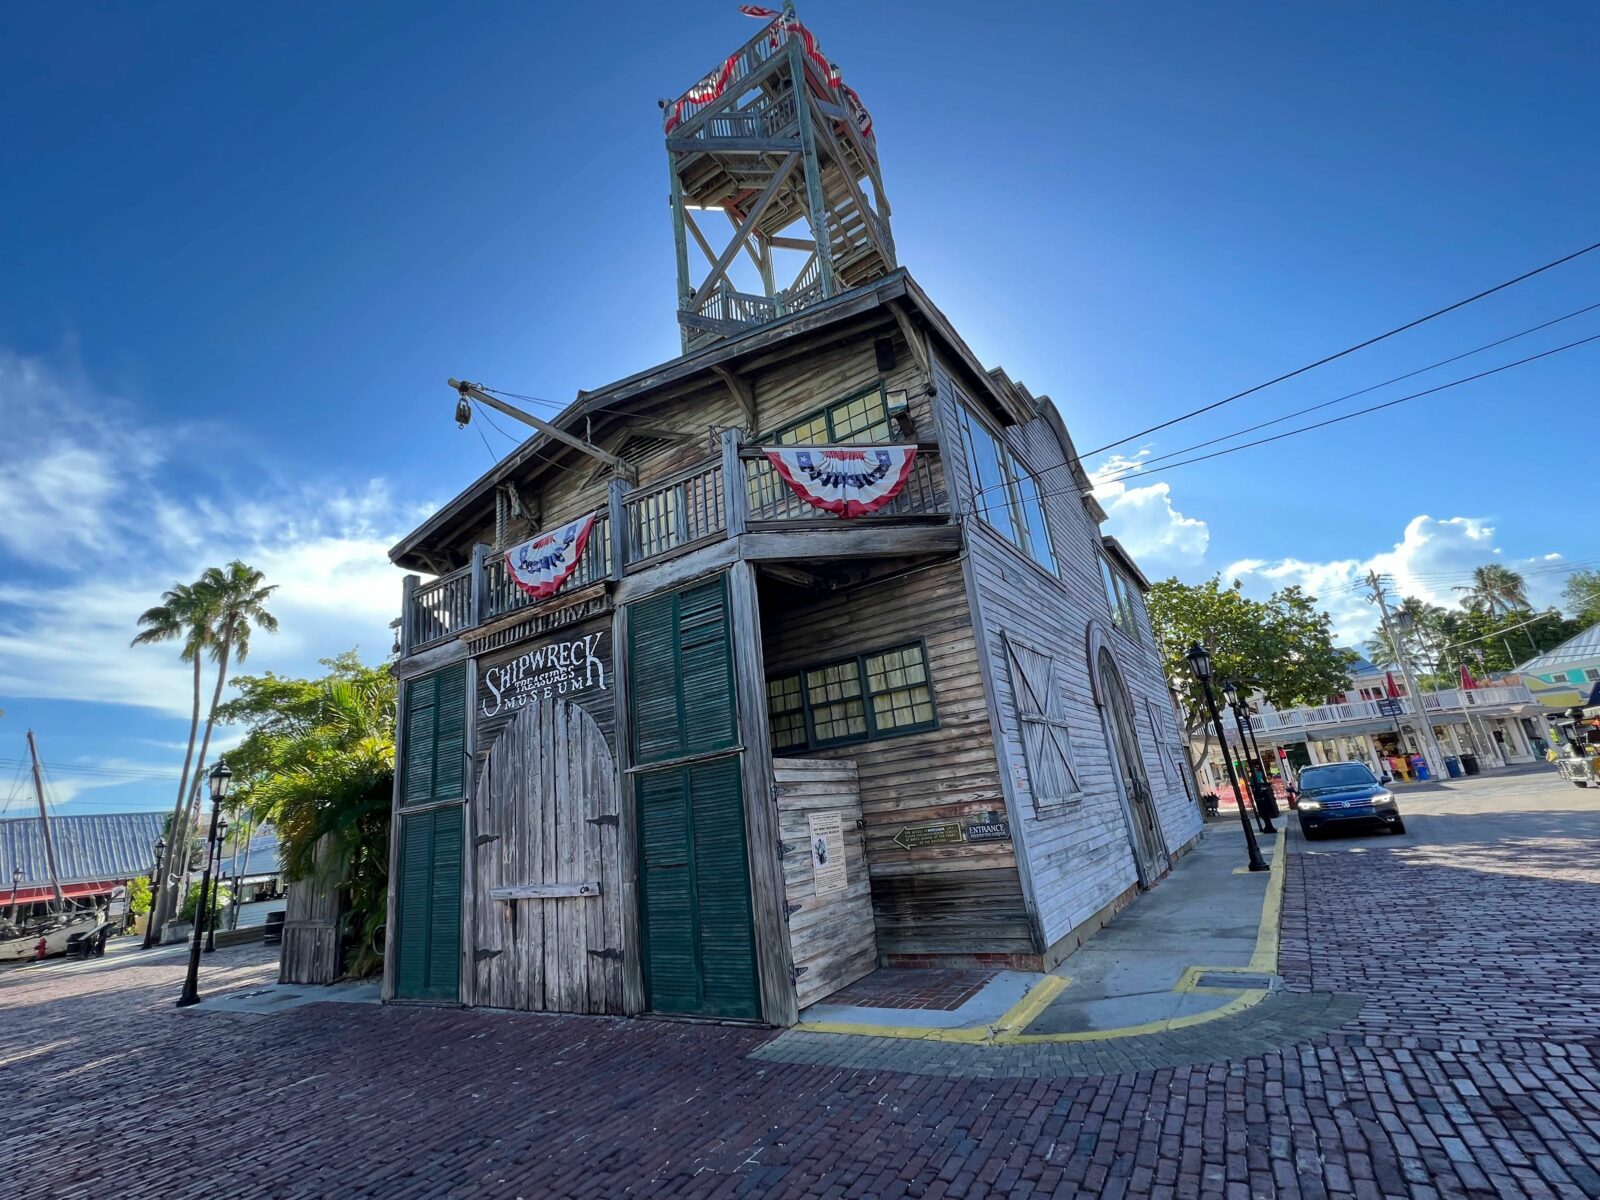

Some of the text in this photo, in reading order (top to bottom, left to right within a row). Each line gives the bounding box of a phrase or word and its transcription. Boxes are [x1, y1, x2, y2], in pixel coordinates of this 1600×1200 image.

[483, 632, 607, 717] SHIPWRECK
[515, 666, 575, 693] TREASURES
[504, 677, 584, 711] MUSEUM
[968, 823, 1005, 834] ENTRANCE
